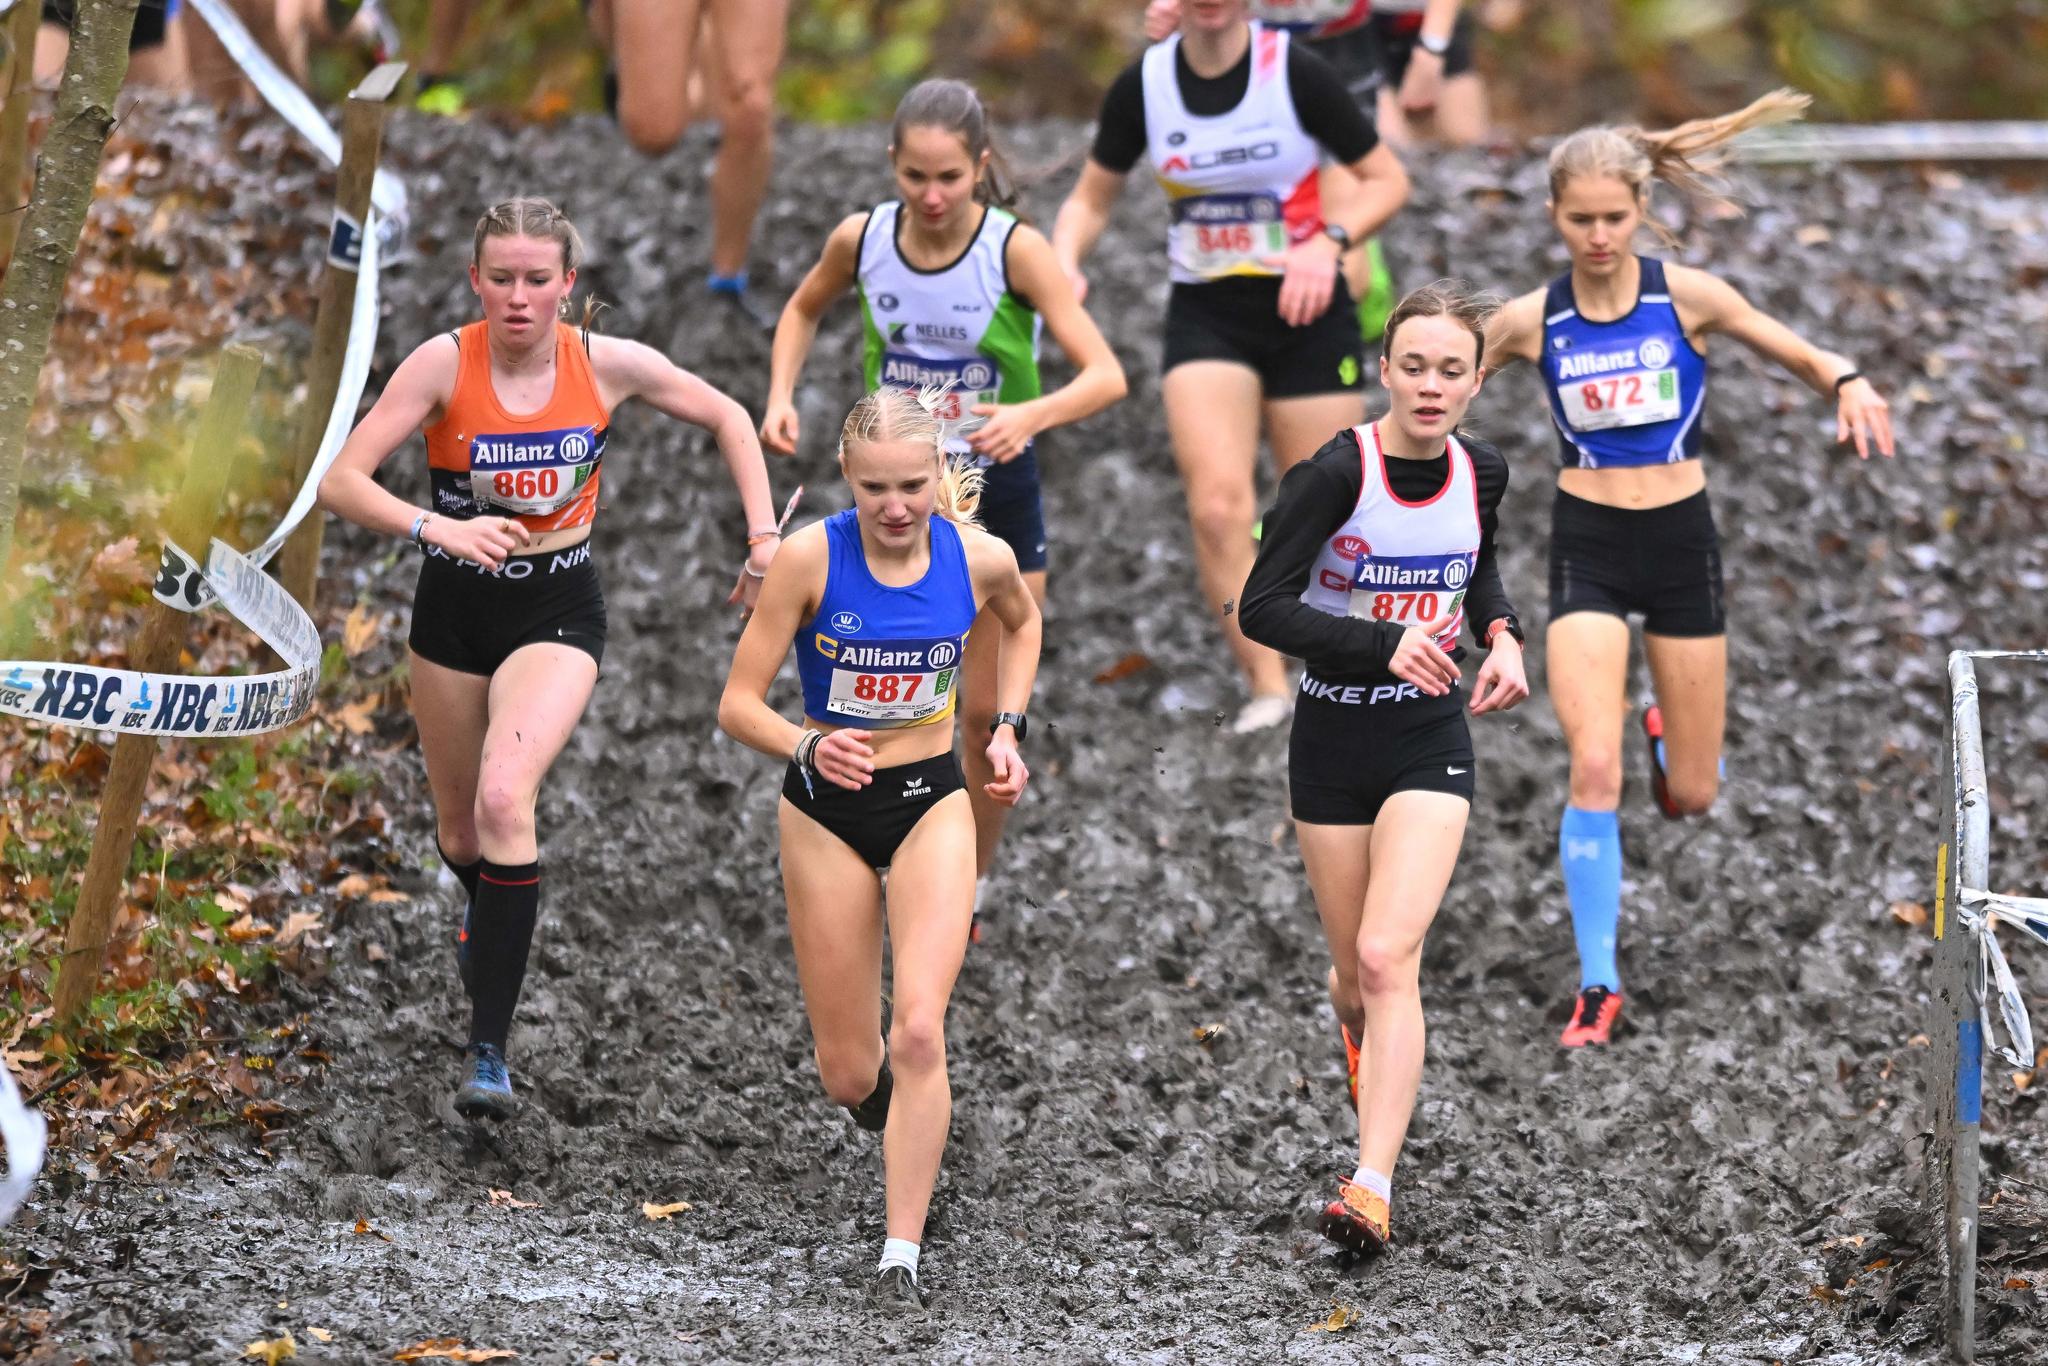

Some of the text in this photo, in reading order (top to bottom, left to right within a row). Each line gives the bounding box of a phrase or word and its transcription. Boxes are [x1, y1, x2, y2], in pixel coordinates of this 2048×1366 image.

[915, 324, 968, 340] NELLES
[1559, 349, 1637, 380] Allianz
[1581, 376, 1644, 412] 872
[475, 442, 555, 464] Allianz
[493, 469, 558, 499] 860
[1358, 564, 1440, 585] Allianz
[1371, 592, 1439, 623] 870
[839, 646, 923, 667] Allianz
[854, 674, 923, 703] 887
[937, 670, 950, 693] 2024
[1299, 671, 1428, 705] NIKE PR
[33, 668, 122, 725] KBC
[120, 712, 147, 729] KBC
[149, 682, 217, 733] KBC
[233, 680, 279, 731] KBC
[846, 706, 871, 716] SCOTT
[902, 786, 931, 798] erima
